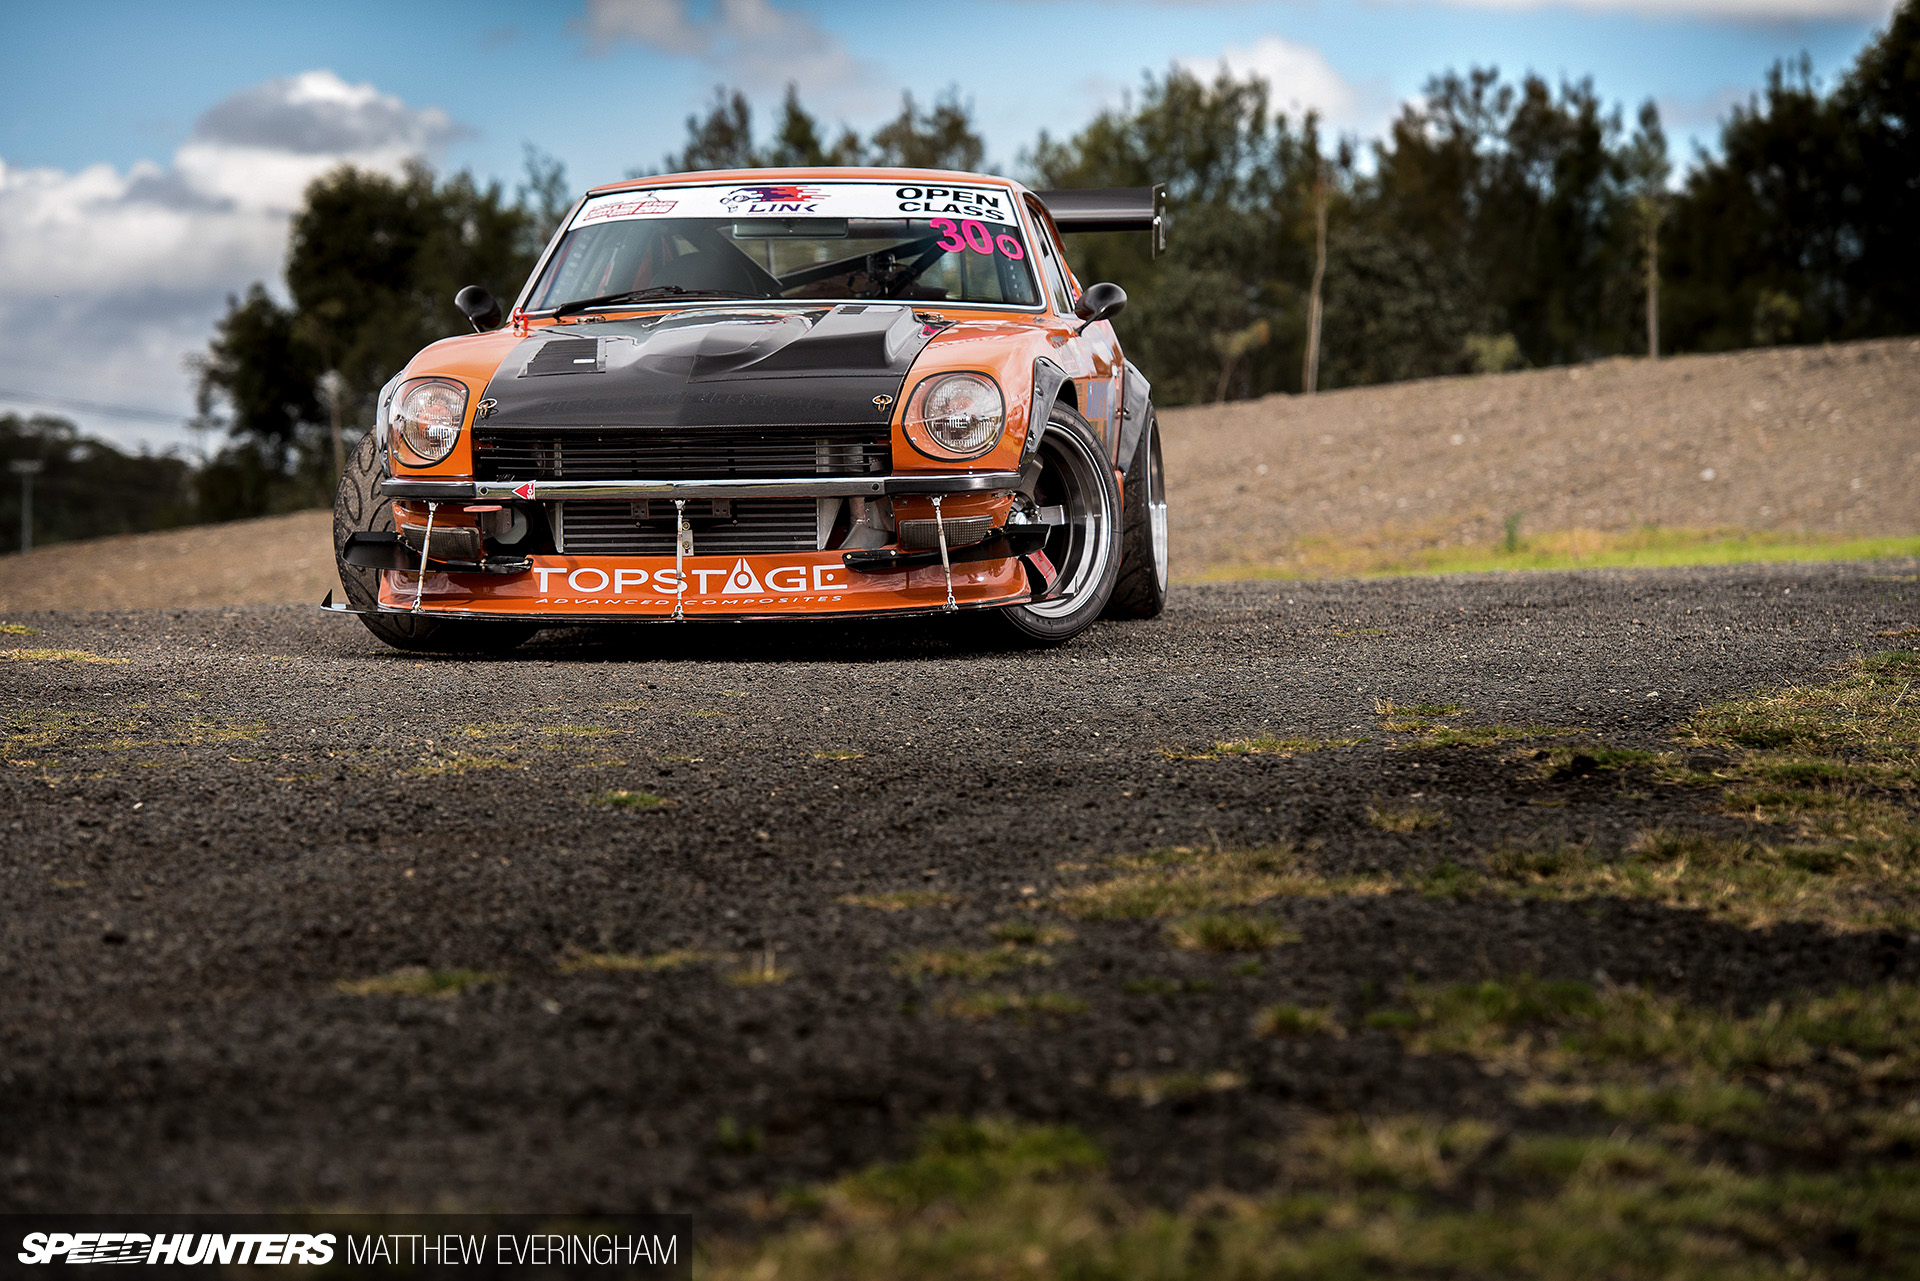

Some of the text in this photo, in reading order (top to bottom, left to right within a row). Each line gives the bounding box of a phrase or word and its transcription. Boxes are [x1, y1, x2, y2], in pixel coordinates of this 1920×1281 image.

[896, 187, 999, 208] OPEN
[748, 203, 819, 213] LINK
[898, 201, 1005, 221] CLASS
[533, 557, 848, 594] TOPSTAGE
[534, 595, 843, 606] ADVANCED COMPOSITES
